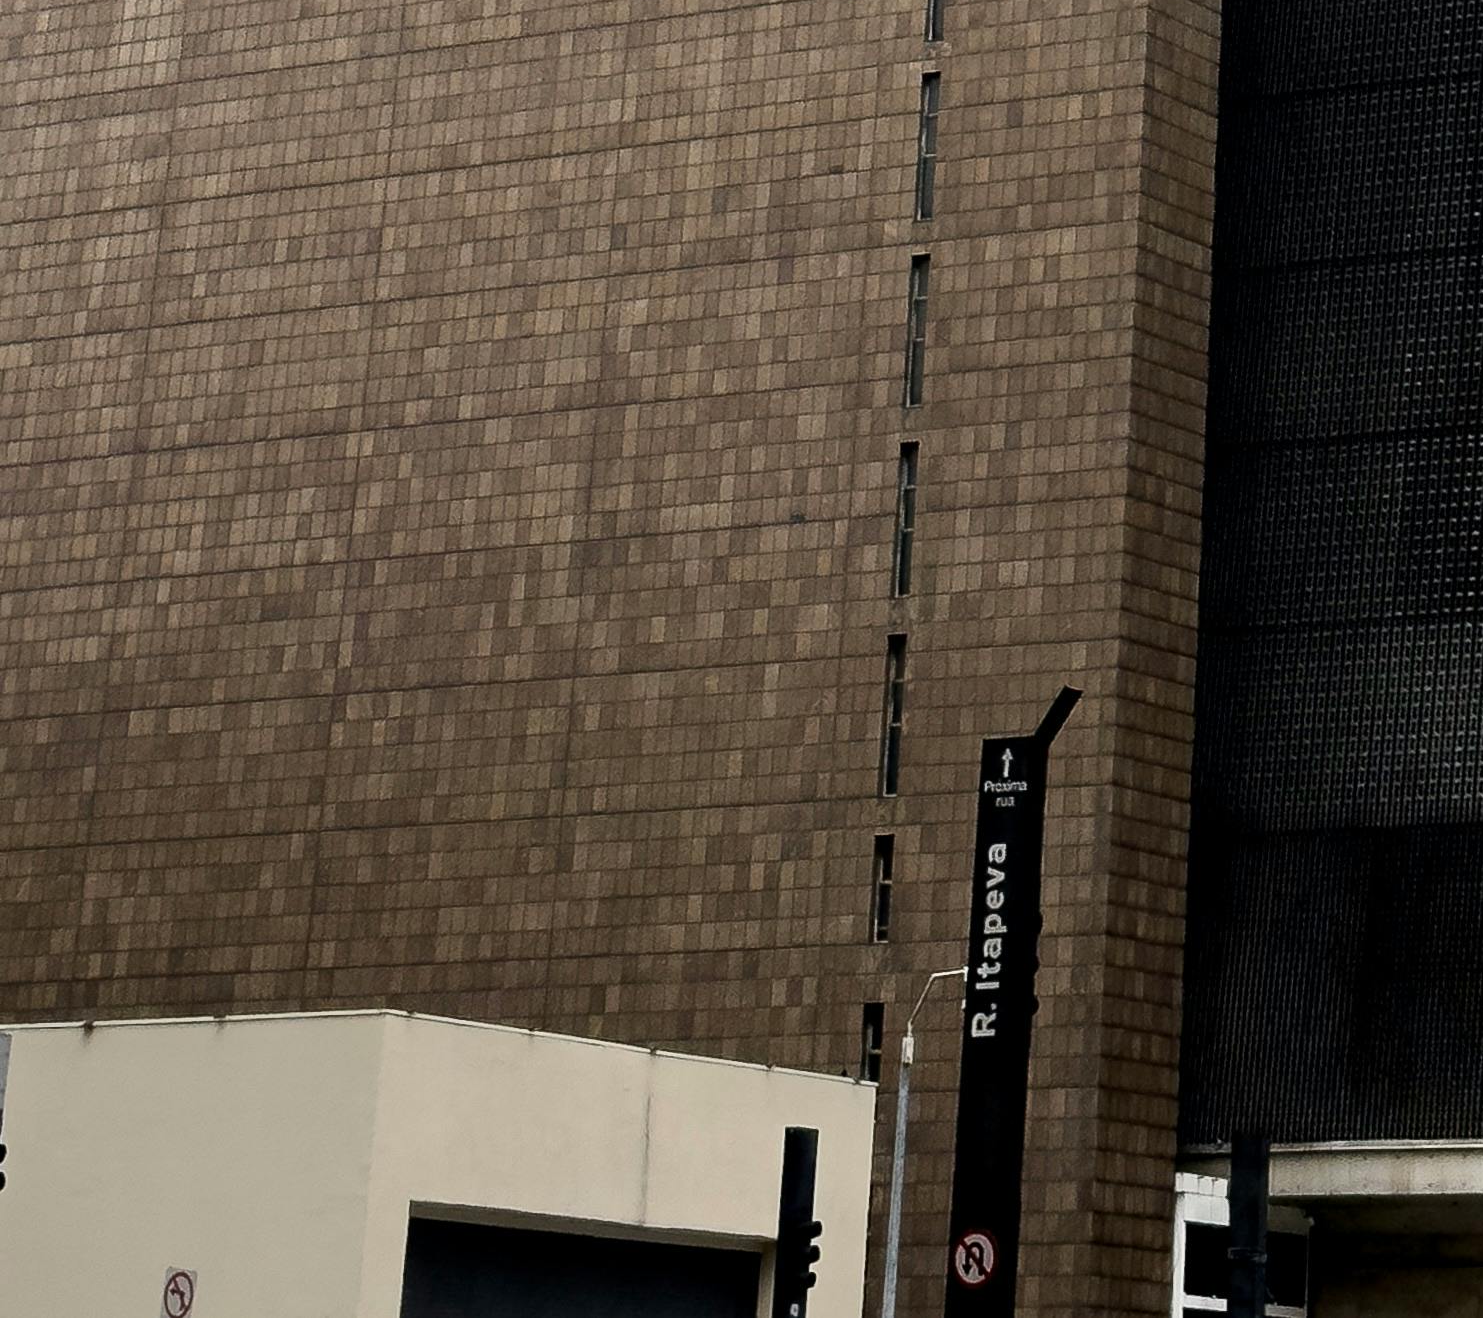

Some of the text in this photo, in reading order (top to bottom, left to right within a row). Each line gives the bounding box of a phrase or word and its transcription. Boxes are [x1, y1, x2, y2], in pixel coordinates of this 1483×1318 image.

[995, 796, 1016, 807] rua
[971, 842, 1008, 1038] R. Itapeva
